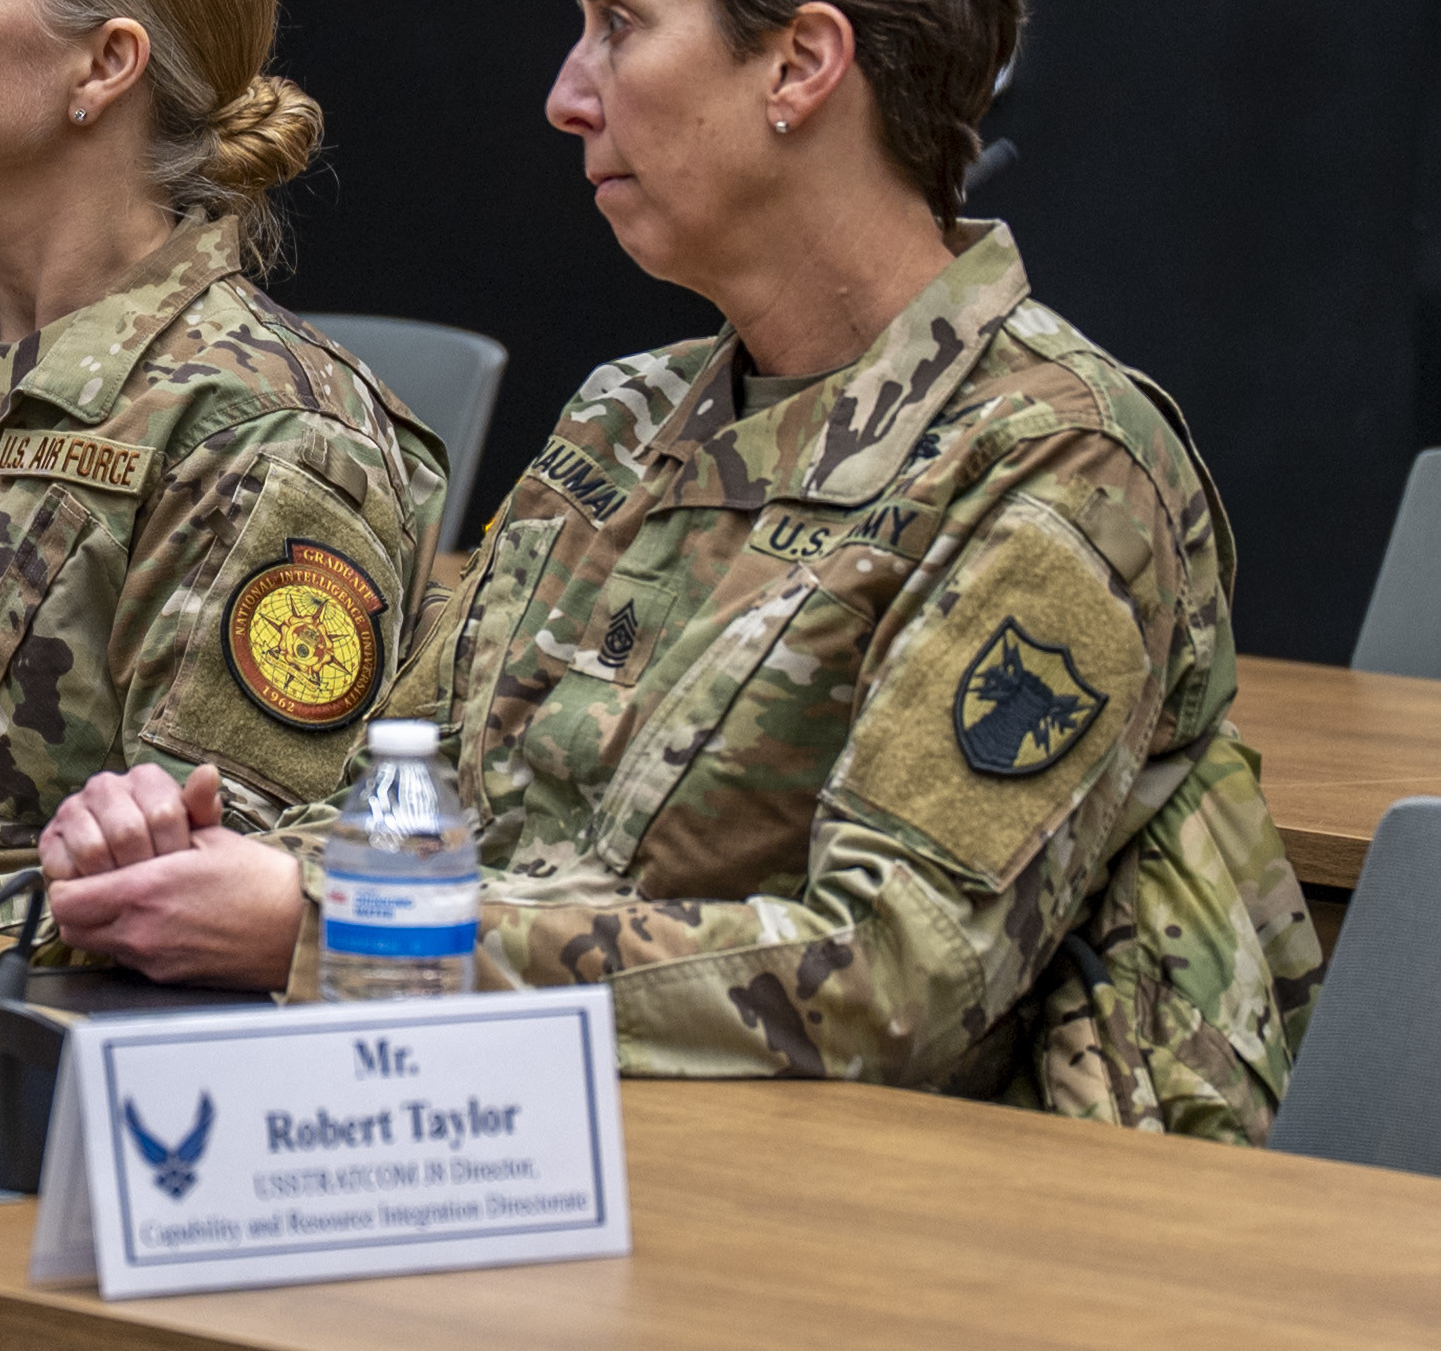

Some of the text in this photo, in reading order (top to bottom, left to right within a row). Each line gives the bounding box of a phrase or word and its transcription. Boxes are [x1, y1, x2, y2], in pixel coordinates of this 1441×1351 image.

[31, 437, 61, 471] AIR
[61, 439, 141, 487] FORCE
[303, 548, 376, 603] GRADUATE
[235, 576, 274, 637] NATIONAL
[279, 569, 366, 626] INTELLIGENCE
[344, 630, 374, 709] UNIVERSITY
[261, 685, 296, 713] 1962
[353, 1037, 420, 1081] Mr.
[265, 1098, 520, 1154] Robert Taylor
[139, 1216, 240, 1250] Capability
[248, 1212, 280, 1239] and
